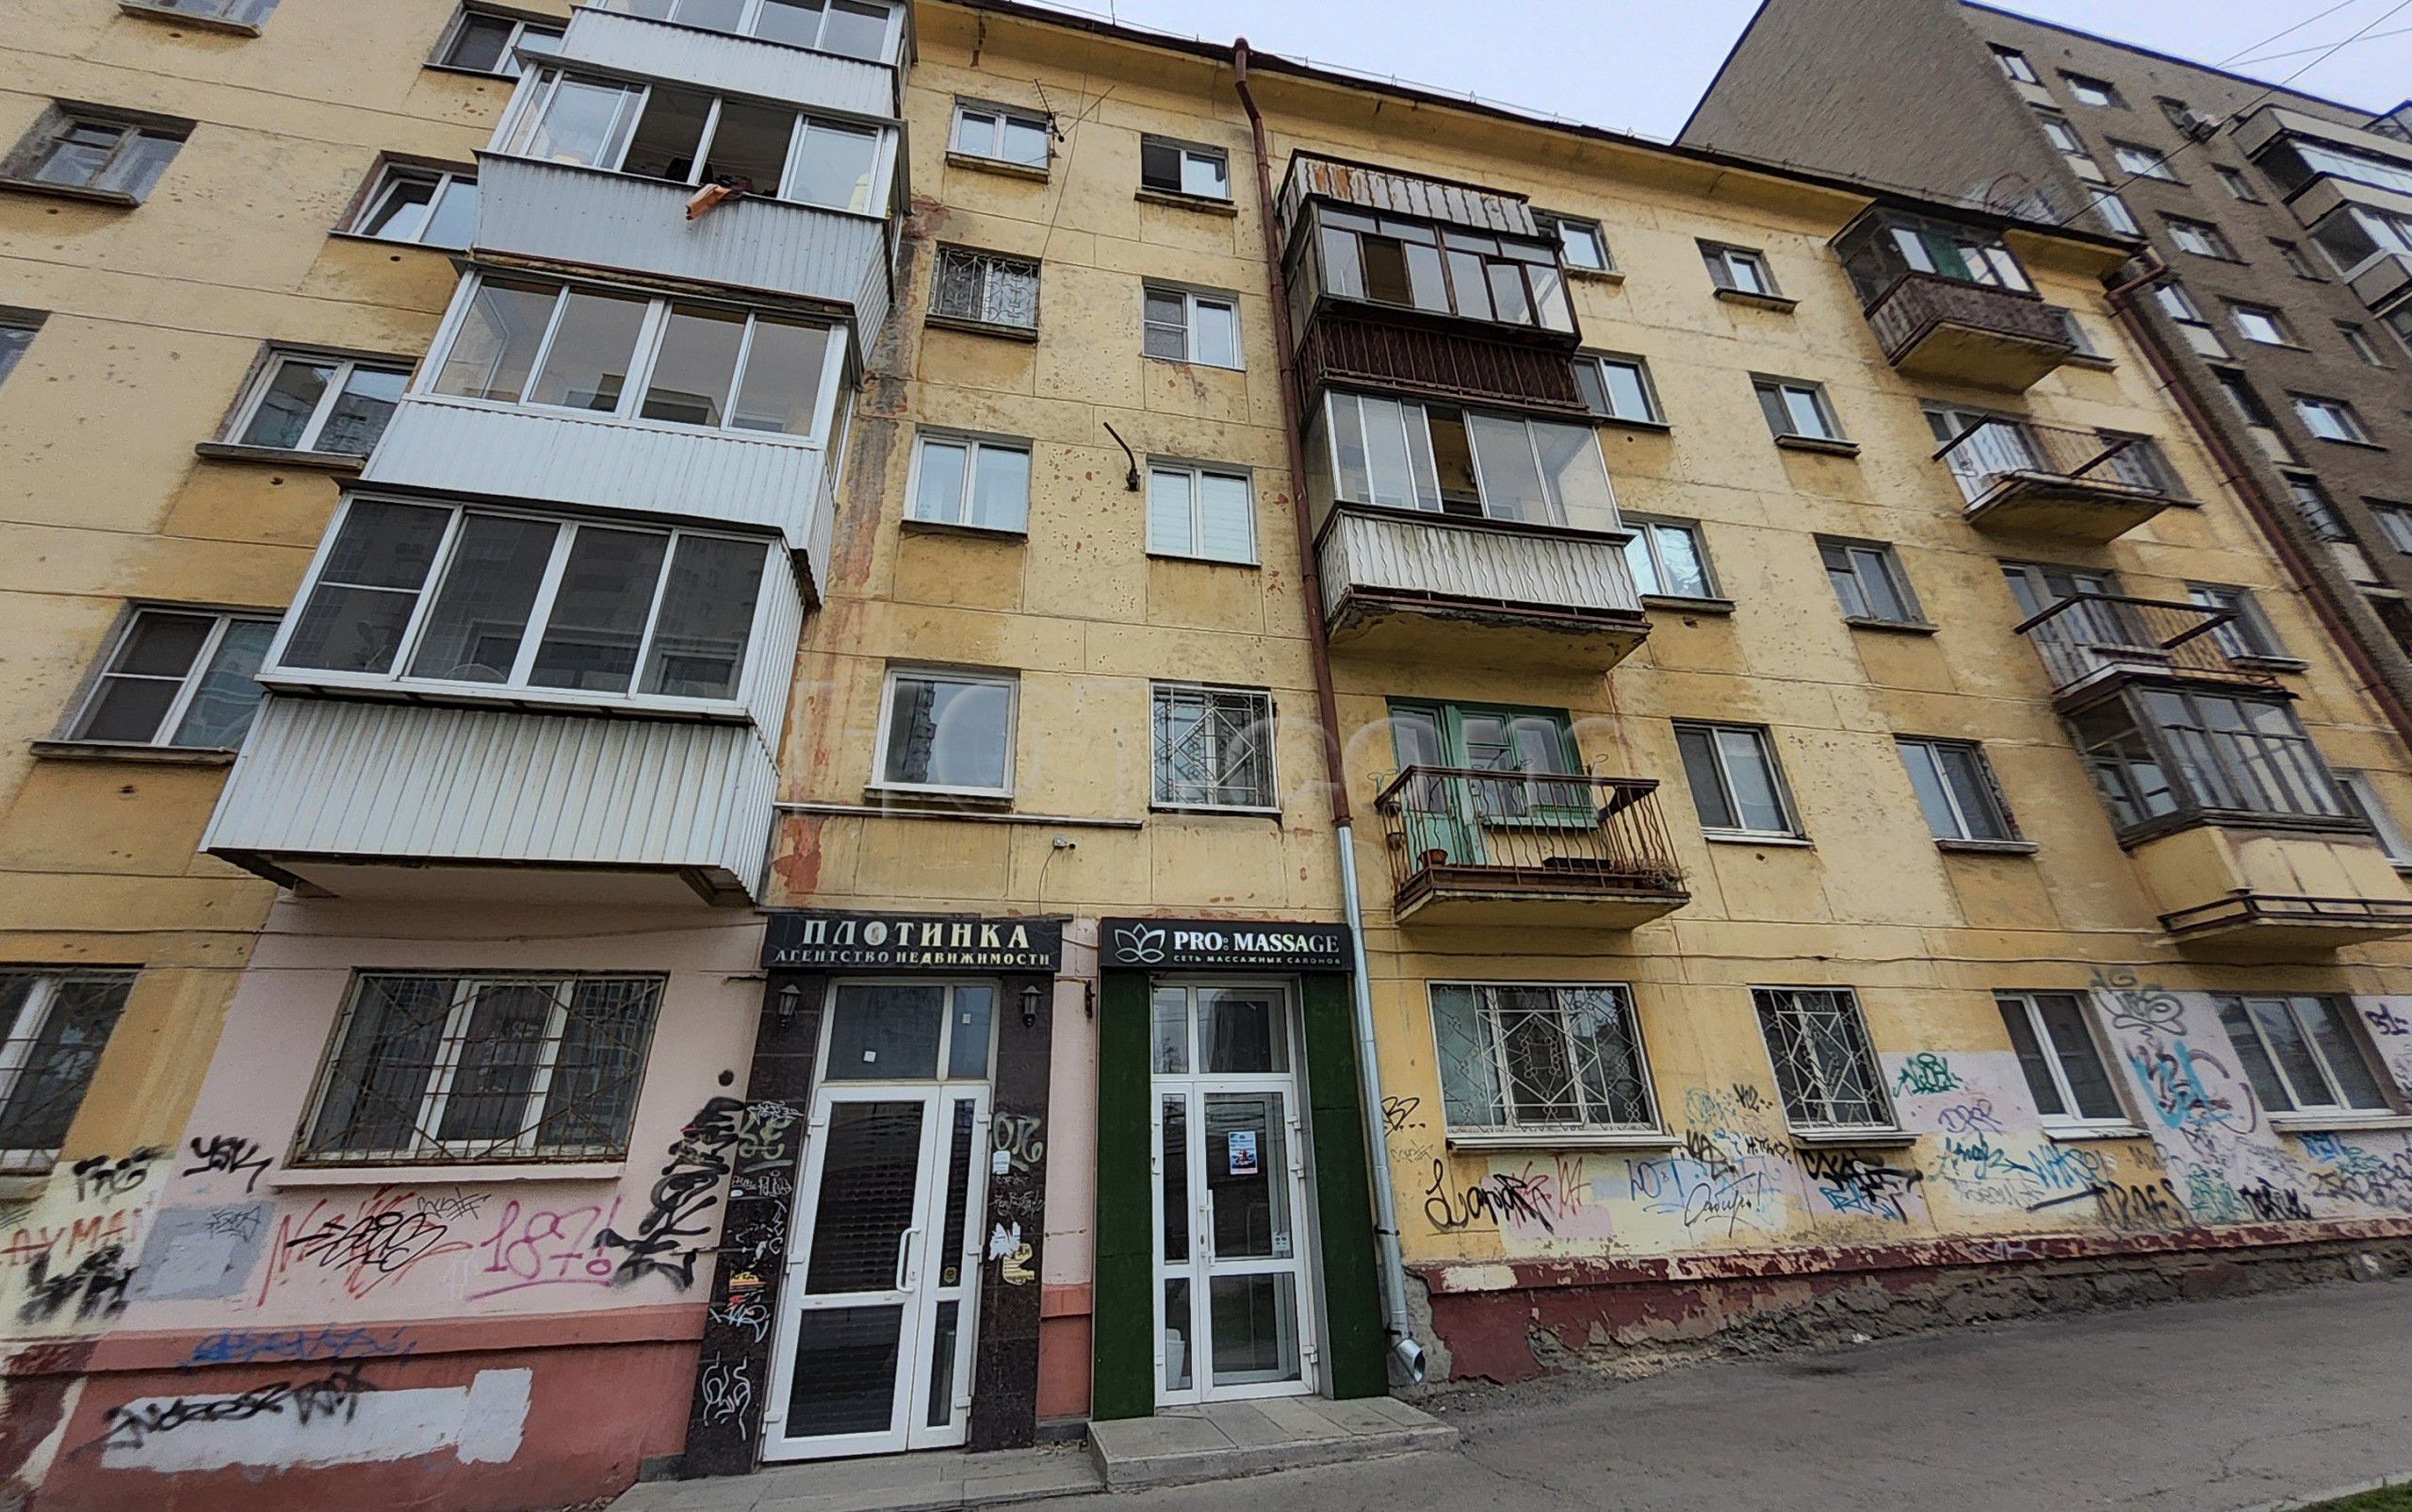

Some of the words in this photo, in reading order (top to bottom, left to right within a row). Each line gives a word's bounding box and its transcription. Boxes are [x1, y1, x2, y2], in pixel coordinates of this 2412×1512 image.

[802, 919, 1030, 948] ПЛОТИНКА
[1232, 933, 1340, 952] MASSAGE
[774, 950, 889, 963] АГЕНТСТВО
[896, 951, 1050, 967] НЕДВИЖИМОСТИ
[1207, 955, 1281, 964] МАССАЖНЫХ
[1286, 956, 1341, 965] САЛОНОВ
